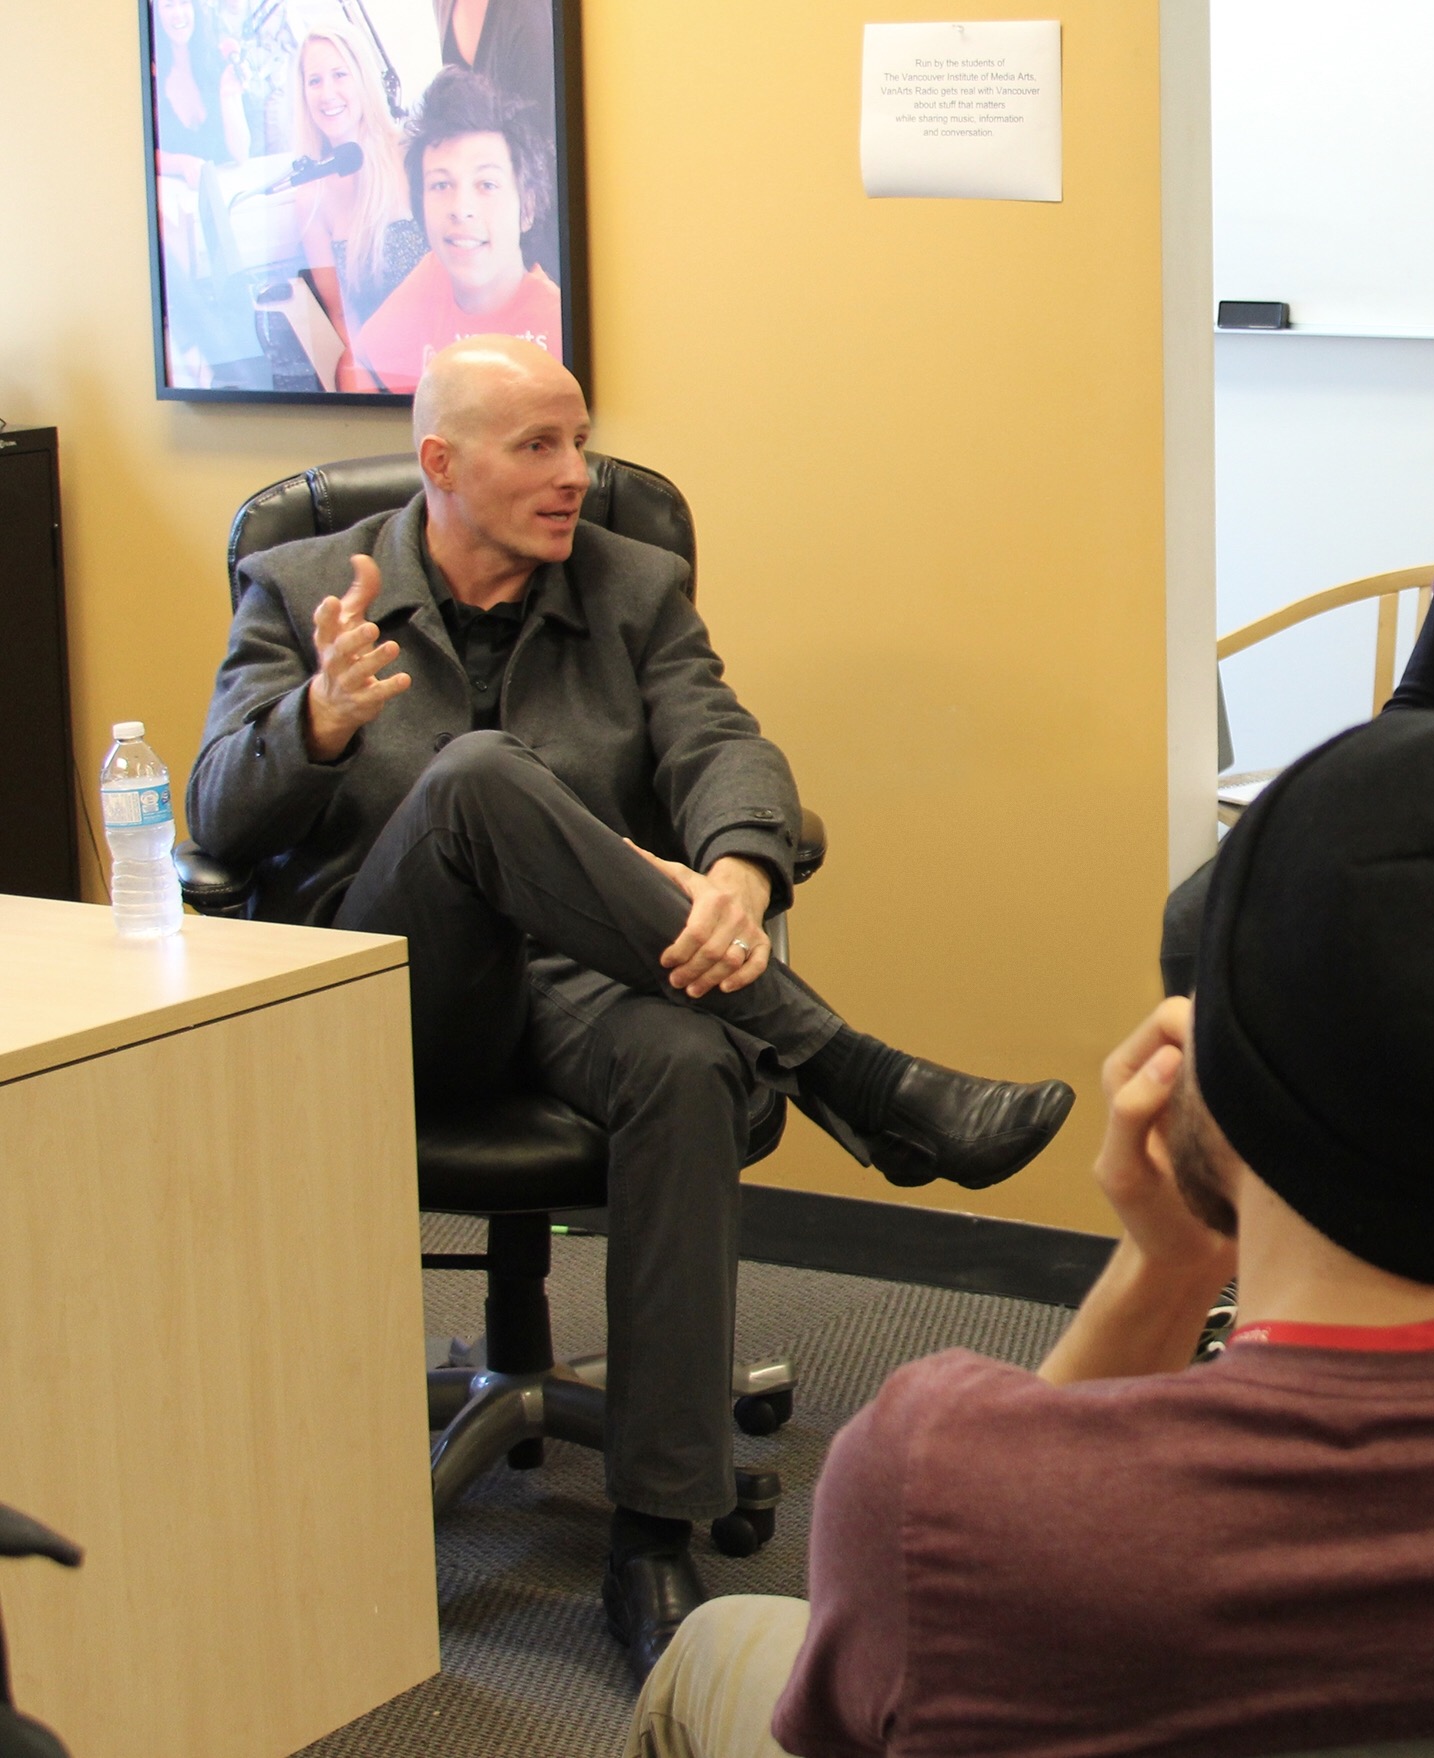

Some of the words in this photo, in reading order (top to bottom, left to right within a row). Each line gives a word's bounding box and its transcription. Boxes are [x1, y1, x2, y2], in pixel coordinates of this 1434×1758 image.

[915, 58, 932, 68] Run
[934, 58, 944, 70] by
[946, 59, 959, 68] the
[961, 58, 995, 68] students
[997, 58, 1005, 68] of
[884, 72, 900, 81] The
[902, 72, 945, 82] Vancouver
[947, 72, 979, 82] Institute
[981, 72, 989, 81] of
[990, 72, 1016, 81] Media
[1017, 72, 1037, 82] Arts,
[880, 86, 913, 96] VanArts
[915, 86, 939, 96] Radio
[941, 87, 958, 98] gets
[960, 86, 976, 95] real
[978, 86, 994, 95] with
[996, 86, 1040, 96] Vancouver
[914, 100, 937, 109] about
[939, 100, 956, 109] stuff
[958, 101, 974, 109] that
[976, 101, 1006, 109] matters
[895, 114, 916, 123] while
[918, 114, 948, 125] sharing
[979, 114, 1024, 123] information
[923, 128, 939, 137] and
